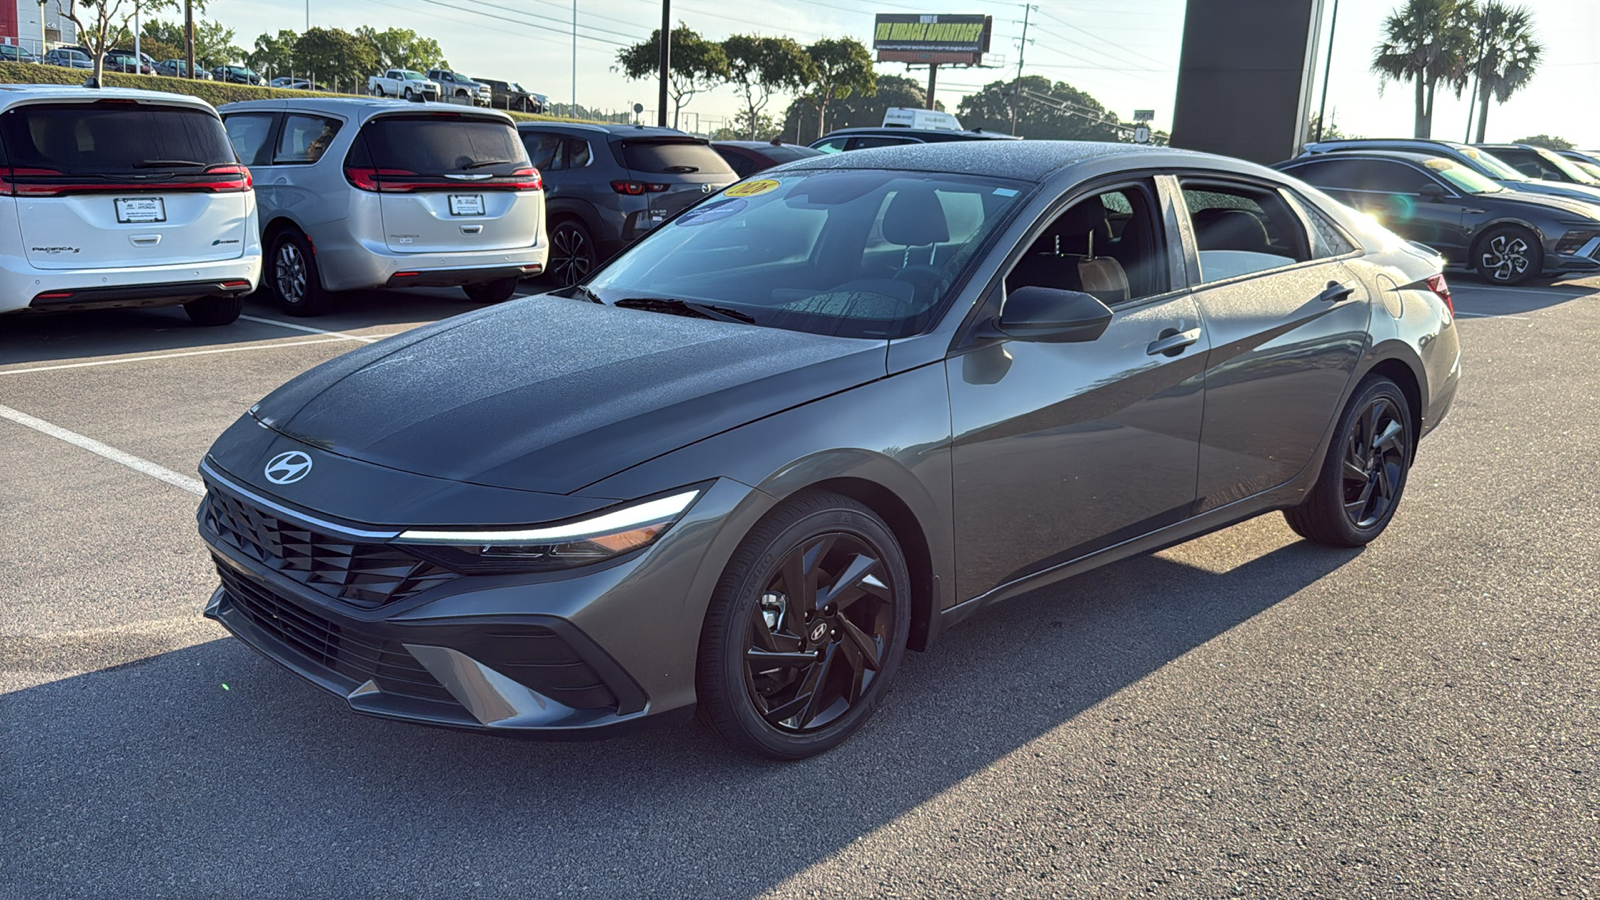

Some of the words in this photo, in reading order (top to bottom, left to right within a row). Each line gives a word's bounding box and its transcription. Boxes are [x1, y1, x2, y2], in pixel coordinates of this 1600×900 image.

[875, 23, 892, 40] THE
[889, 23, 928, 41] MIRACLE
[925, 23, 983, 42] ADVANTAGE?
